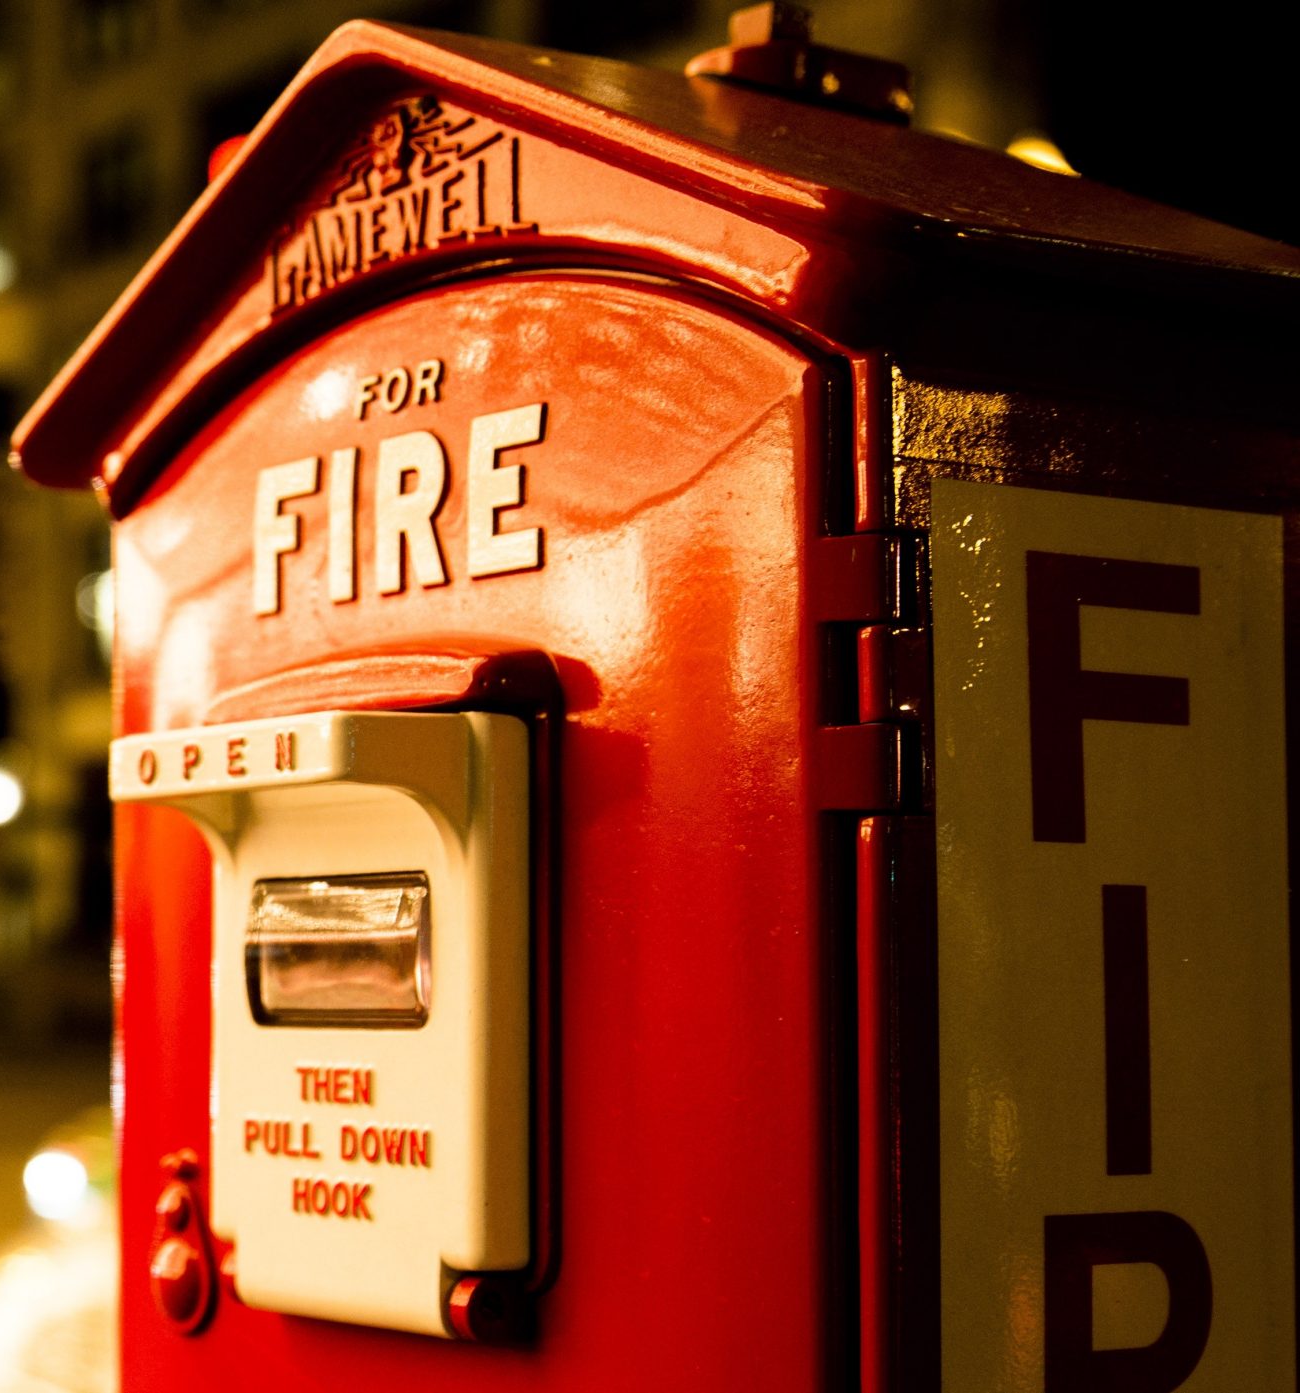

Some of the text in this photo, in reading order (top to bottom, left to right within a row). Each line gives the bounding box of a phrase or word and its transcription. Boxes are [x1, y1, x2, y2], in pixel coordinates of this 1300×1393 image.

[353, 358, 443, 421] FOR
[253, 402, 548, 618] FIRE
[138, 731, 297, 785] OPEN
[296, 1066, 375, 1106] THEN
[244, 1119, 432, 1169] PULL DOWN
[292, 1178, 374, 1221] HOOK
